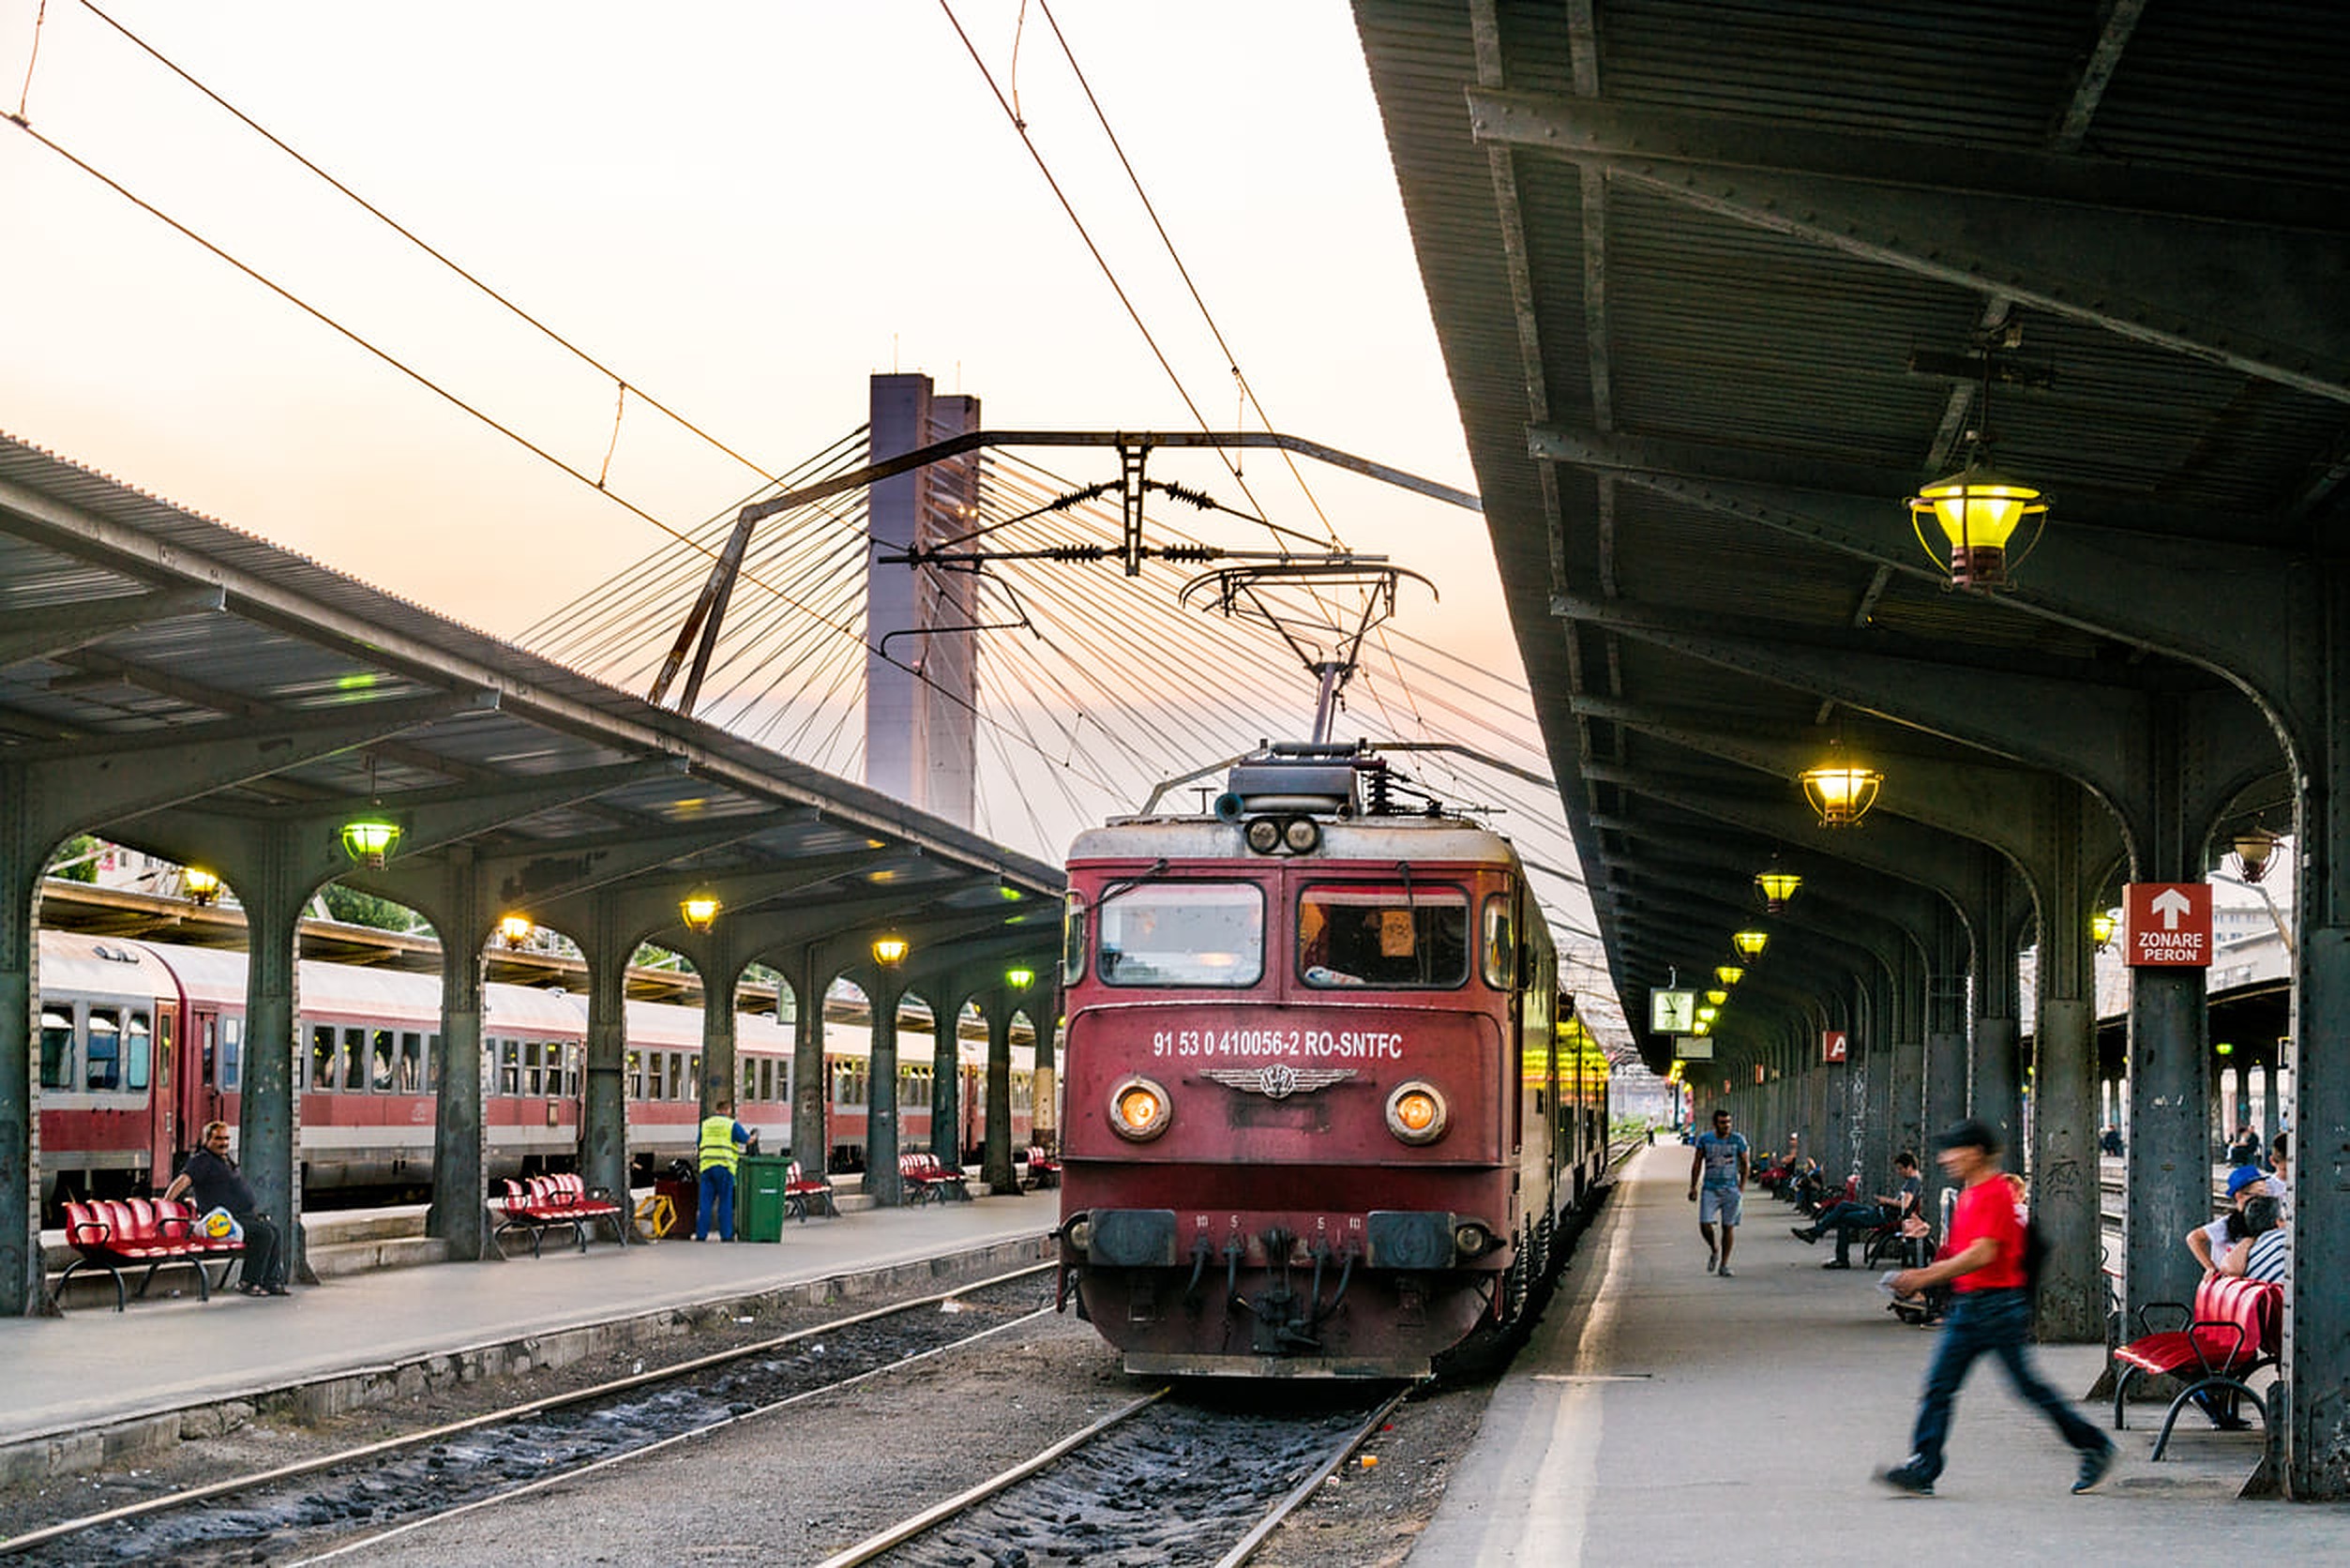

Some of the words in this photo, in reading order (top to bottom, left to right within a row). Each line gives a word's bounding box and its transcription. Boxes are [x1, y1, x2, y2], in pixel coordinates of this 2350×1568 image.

[2138, 932, 2203, 948] ZONARE
[2144, 948, 2197, 961] PERON
[1154, 1031, 1173, 1057] 91
[1179, 1030, 1200, 1057] 53
[1204, 1030, 1215, 1056] 0
[1219, 1030, 1301, 1056] 410056-2
[1304, 1031, 1402, 1059] RO-SNTFC
